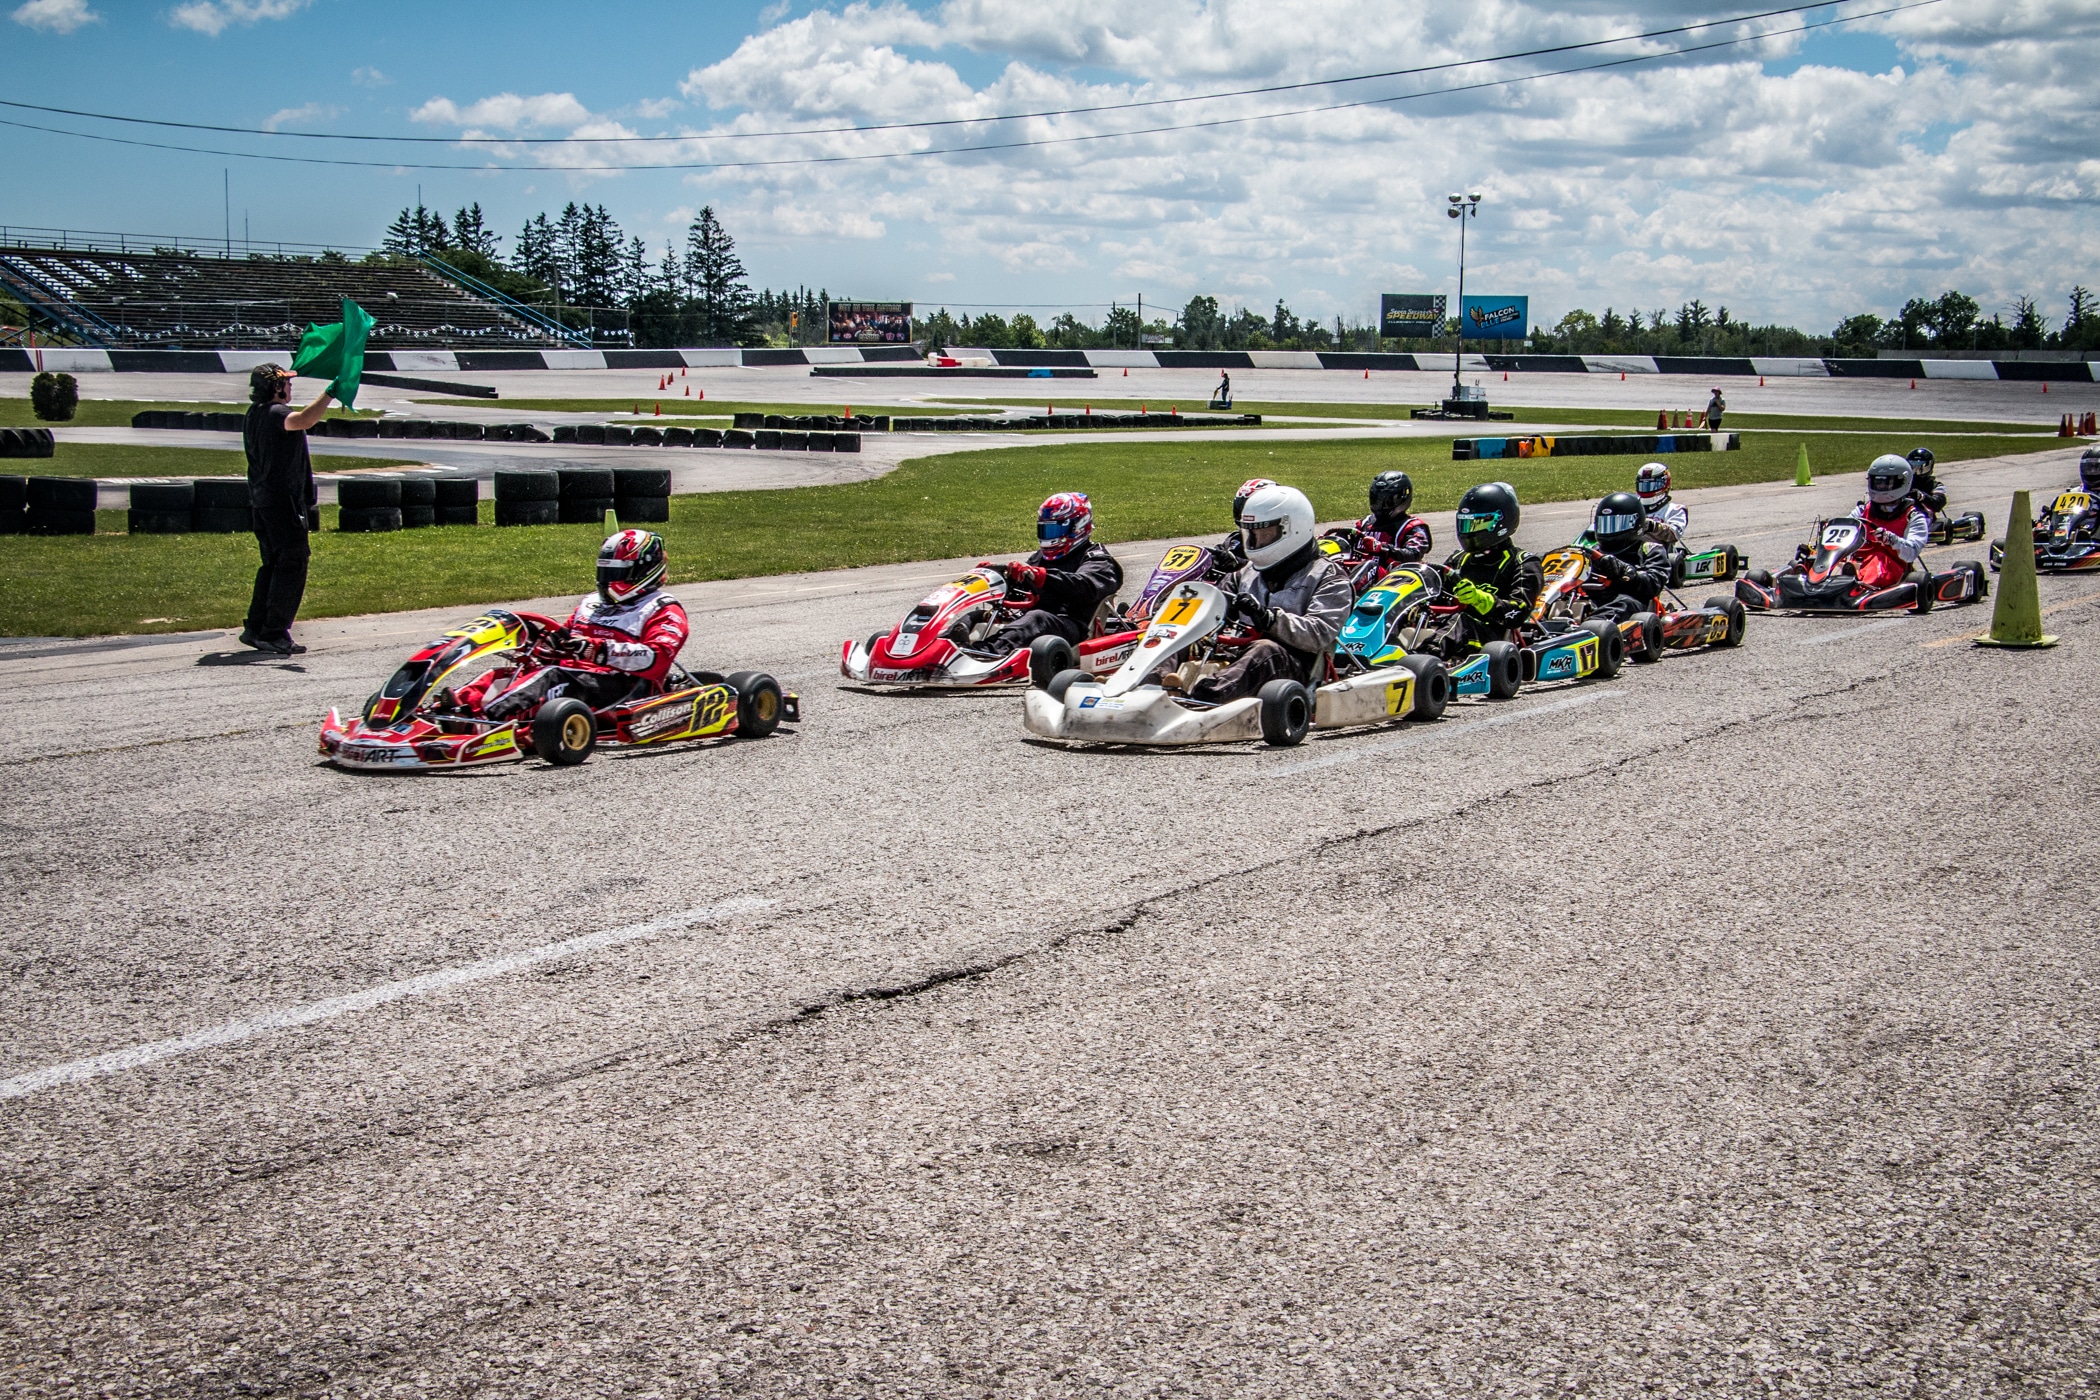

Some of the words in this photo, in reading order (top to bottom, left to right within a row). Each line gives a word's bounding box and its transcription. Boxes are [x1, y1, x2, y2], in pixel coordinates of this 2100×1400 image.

[1386, 311, 1439, 320] SPEEDWAY
[1484, 306, 1515, 321] FALCON
[1162, 553, 1194, 568] 31
[1169, 602, 1191, 622] 7
[1548, 655, 1574, 671] MKR
[1579, 642, 1597, 672] 17
[873, 668, 922, 682] birelART
[1393, 681, 1408, 714] 7
[641, 702, 692, 727] Collison
[690, 689, 728, 733] 12
